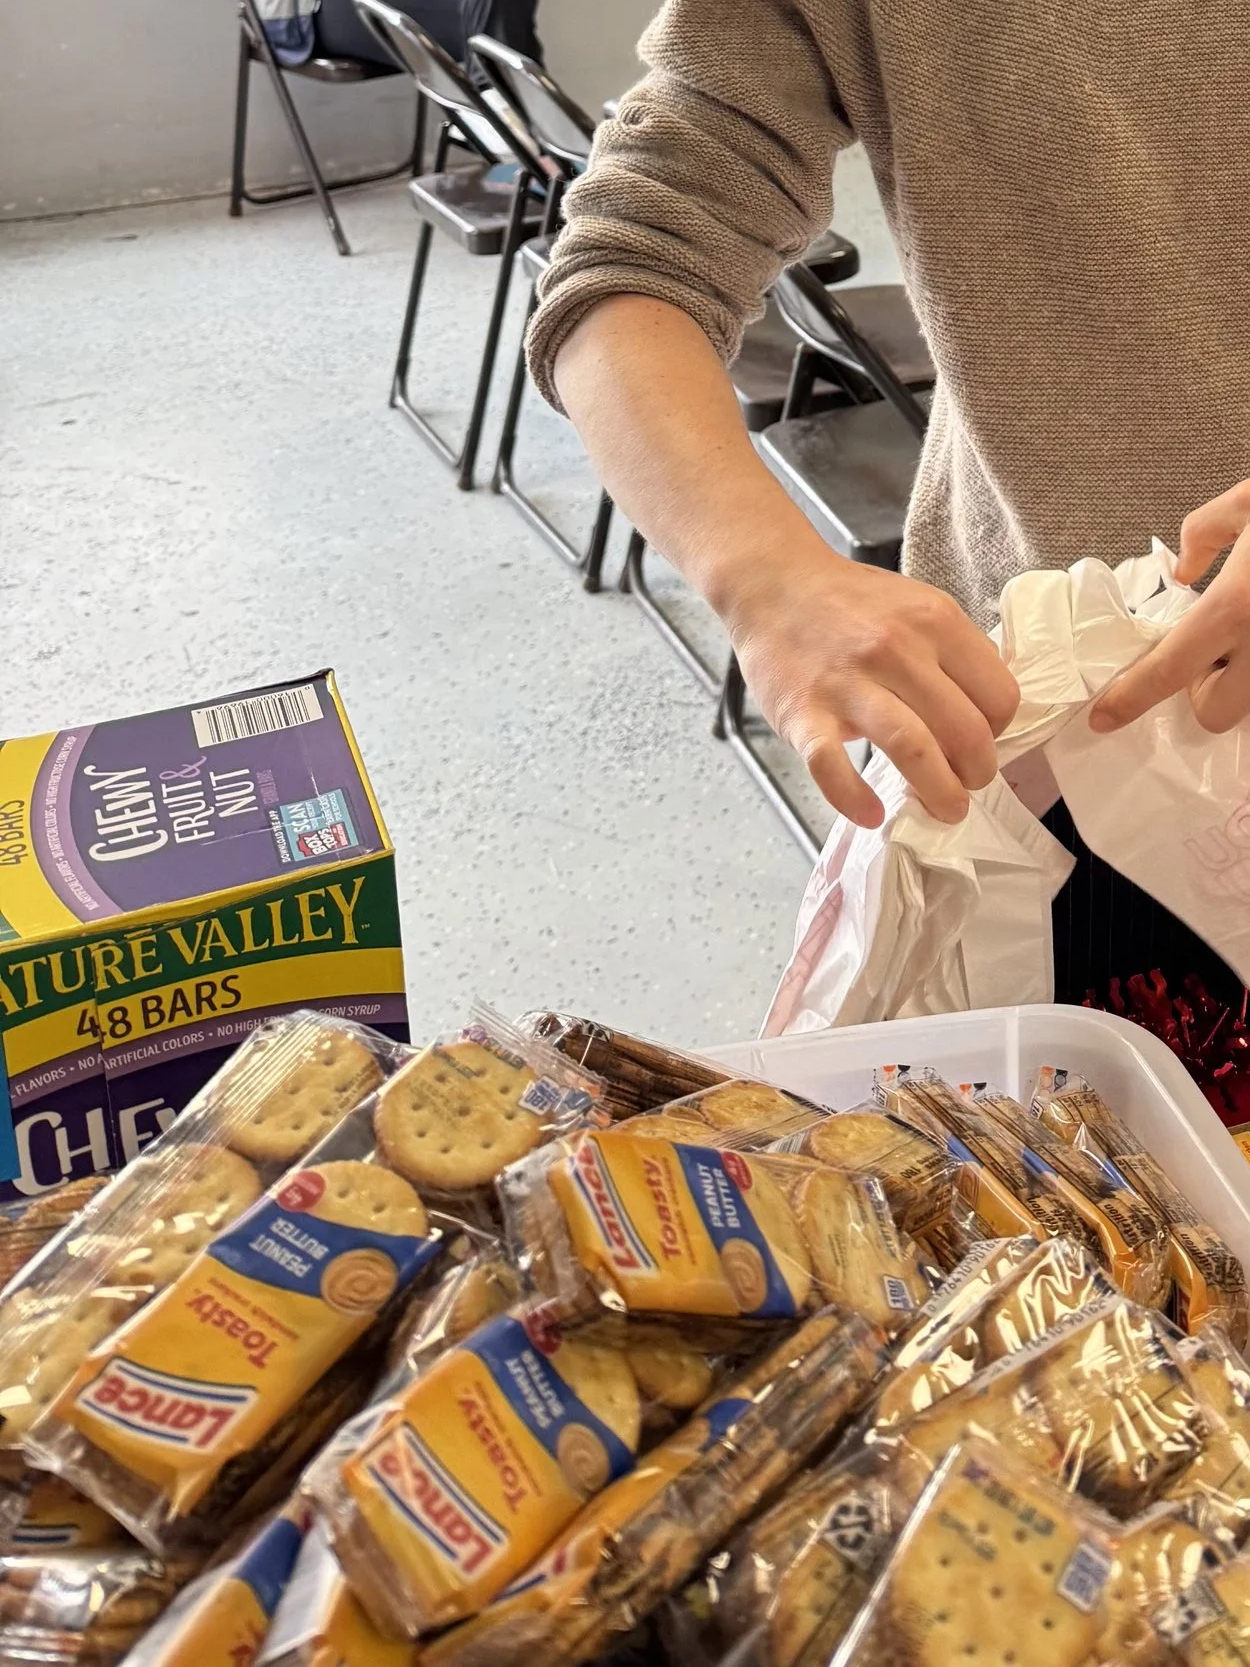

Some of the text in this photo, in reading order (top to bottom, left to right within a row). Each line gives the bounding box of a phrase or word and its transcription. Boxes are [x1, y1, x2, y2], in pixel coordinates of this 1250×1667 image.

[83, 764, 169, 862] CHEWY
[158, 755, 216, 844] FRUIT &
[209, 768, 259, 818] NUT
[268, 809, 279, 821] APP
[287, 801, 312, 833] SCAN
[0, 799, 29, 866] 48 BARS
[275, 831, 291, 863] DOWNLOAD
[303, 833, 329, 856] BOX
[317, 827, 338, 850] TOPS
[167, 876, 366, 963] VALLEY
[76, 974, 243, 1044] 48 BARS
[14, 1066, 67, 1096] FLAVORS
[77, 1054, 96, 1072] NO
[96, 1039, 162, 1072] ARTIFICIAL
[161, 1030, 206, 1055] COLORS
[216, 1024, 234, 1038] NO
[234, 1018, 262, 1034] HIGH
[347, 1003, 382, 1017] SYRUP
[643, 1155, 682, 1261] Toasty
[696, 1162, 726, 1229] PEANUT
[712, 1167, 743, 1230] BUTTER
[247, 1232, 313, 1279] PEANUT
[269, 1217, 329, 1260] BUTTER
[184, 1293, 280, 1370] Toasty
[92, 1374, 236, 1450] Lance
[504, 1356, 553, 1430] PEANUT
[519, 1349, 567, 1417] BUTTER
[457, 1398, 527, 1515] Toasty
